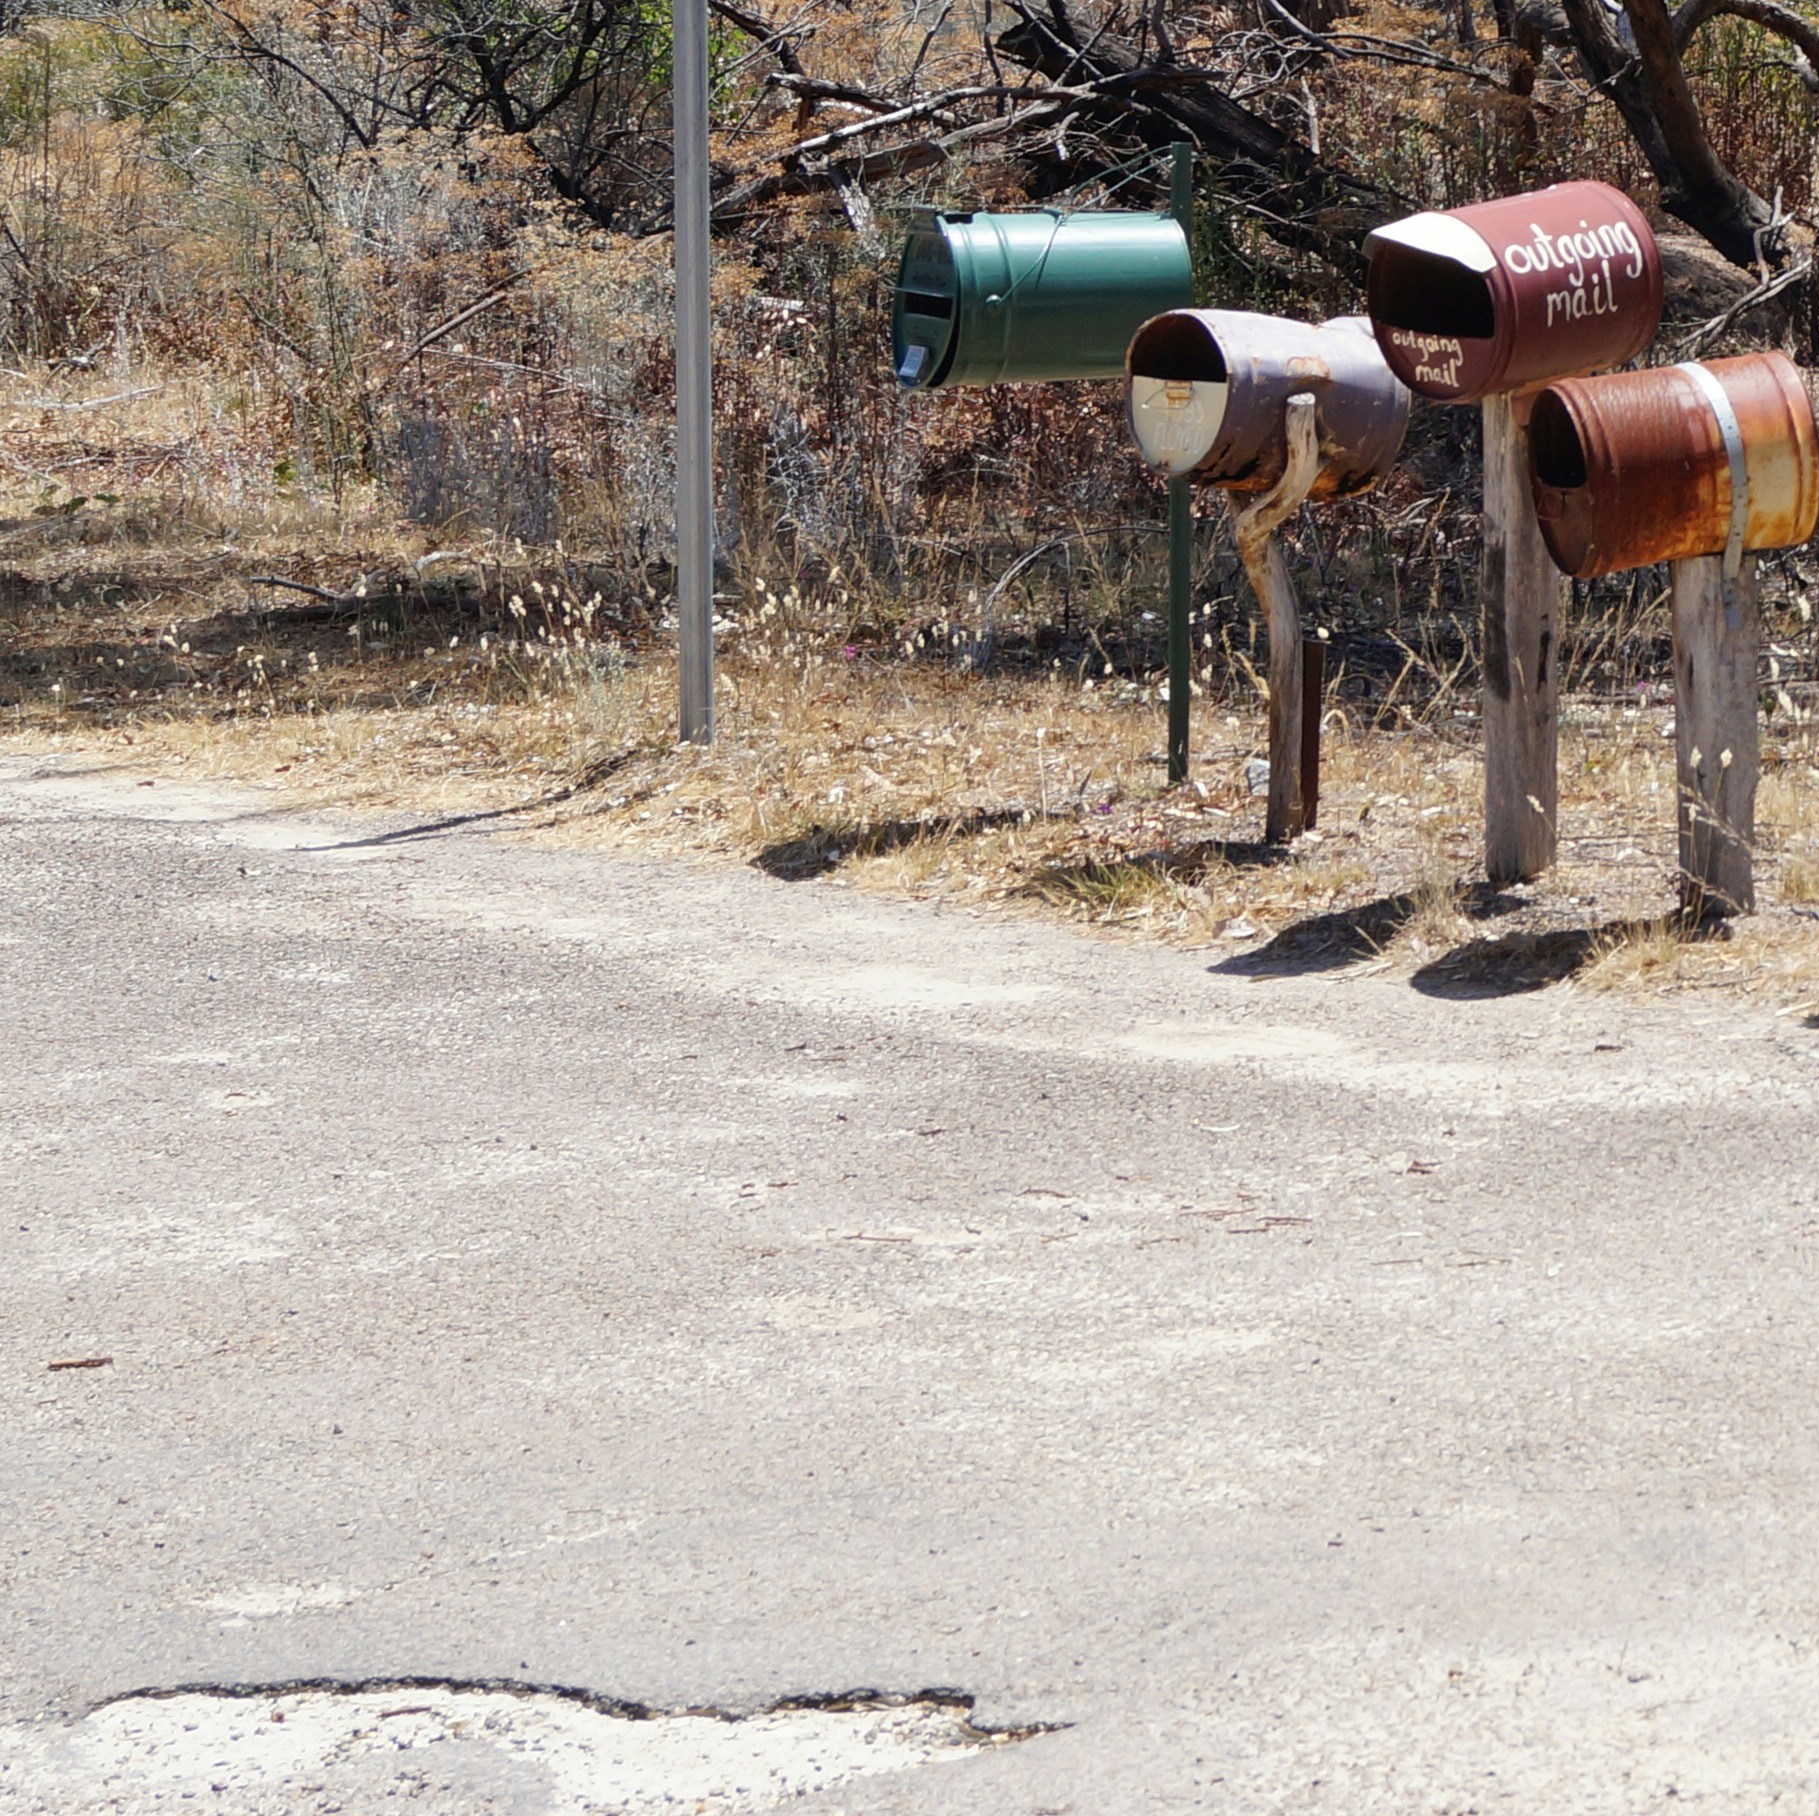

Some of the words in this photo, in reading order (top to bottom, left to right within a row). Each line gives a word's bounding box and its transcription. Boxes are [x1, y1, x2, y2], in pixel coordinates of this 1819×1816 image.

[1504, 219, 1644, 287] outgoing
[1546, 259, 1619, 328] mail
[1392, 329, 1464, 367] outgoing
[1415, 357, 1460, 388] mail
